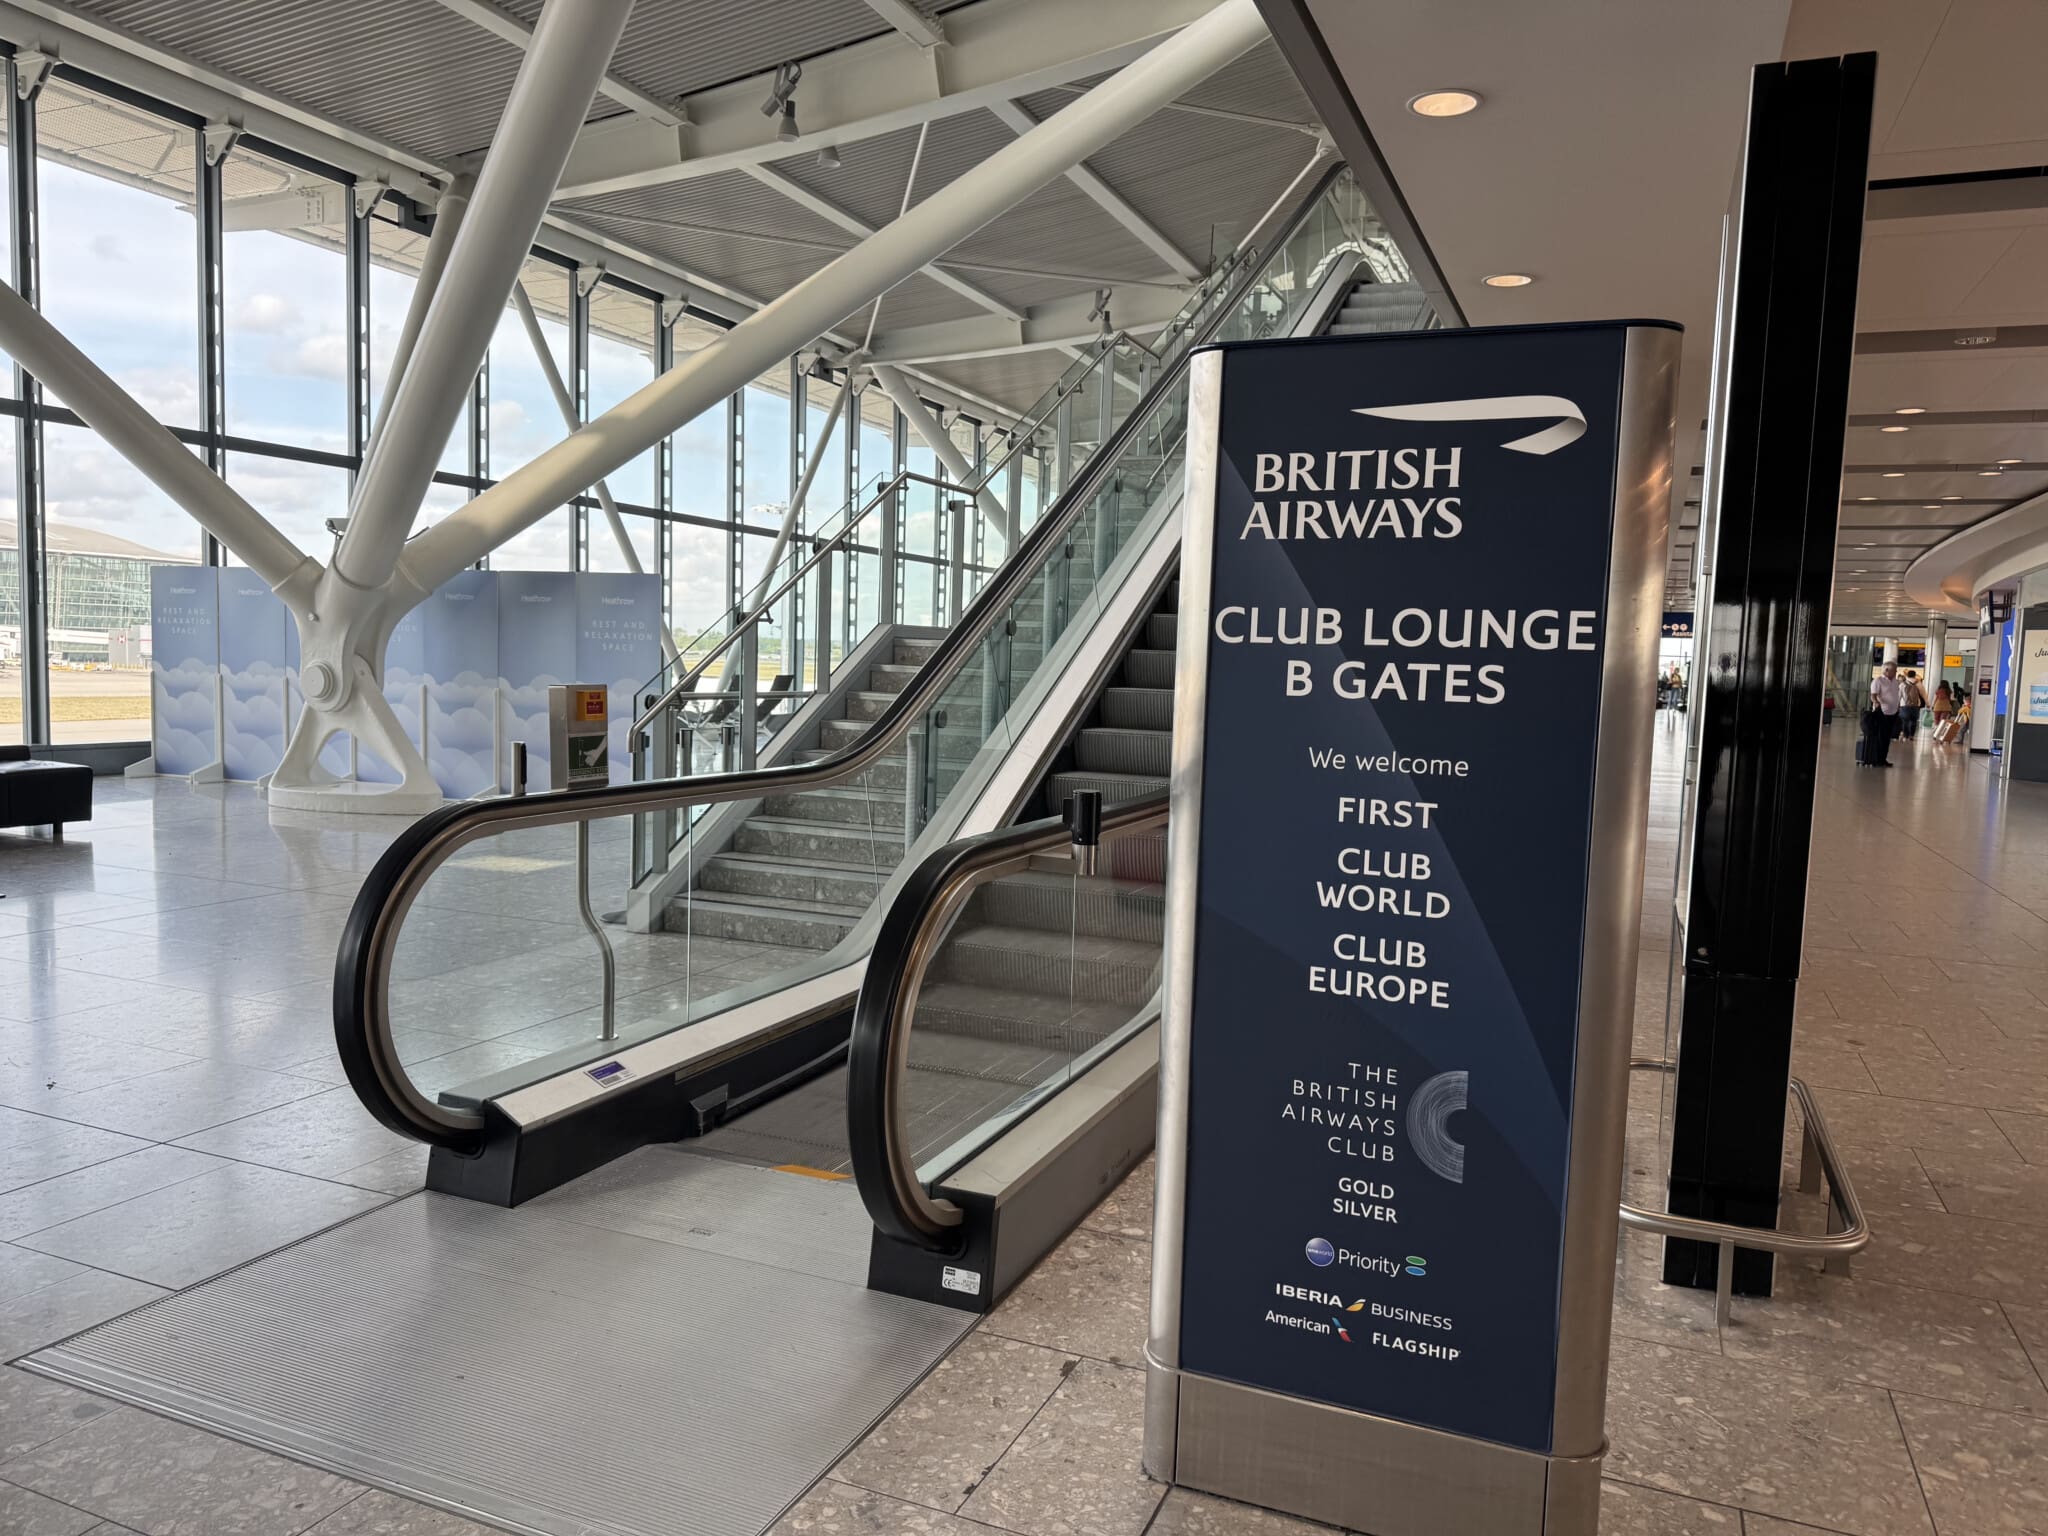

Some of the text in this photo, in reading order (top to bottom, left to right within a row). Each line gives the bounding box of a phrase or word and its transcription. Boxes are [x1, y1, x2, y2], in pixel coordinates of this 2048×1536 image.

[1255, 448, 1462, 493] BRITISH
[1240, 497, 1463, 540] AIRWAYS
[1215, 606, 1596, 651] CLUB LOUNGE
[1285, 659, 1506, 705] B GATES
[1308, 747, 1469, 777] We welcome
[1338, 797, 1439, 829] FIRST
[1337, 848, 1432, 881] CLUB
[1316, 881, 1451, 919] WORLD
[1333, 934, 1427, 968] CLUB
[1309, 966, 1450, 1009] EUROPE
[1347, 1062, 1398, 1085] THE
[1292, 1080, 1397, 1111] BRITISH
[1281, 1104, 1396, 1136] AIRWAYS
[1327, 1136, 1395, 1162] CLUB
[1338, 1177, 1395, 1200] GOLD
[1333, 1199, 1397, 1224] SILVER
[1338, 1248, 1401, 1278] Priority
[1276, 1283, 1453, 1331] IBERIA BUSINESS
[1265, 1310, 1460, 1361] American FLAGSHIP
